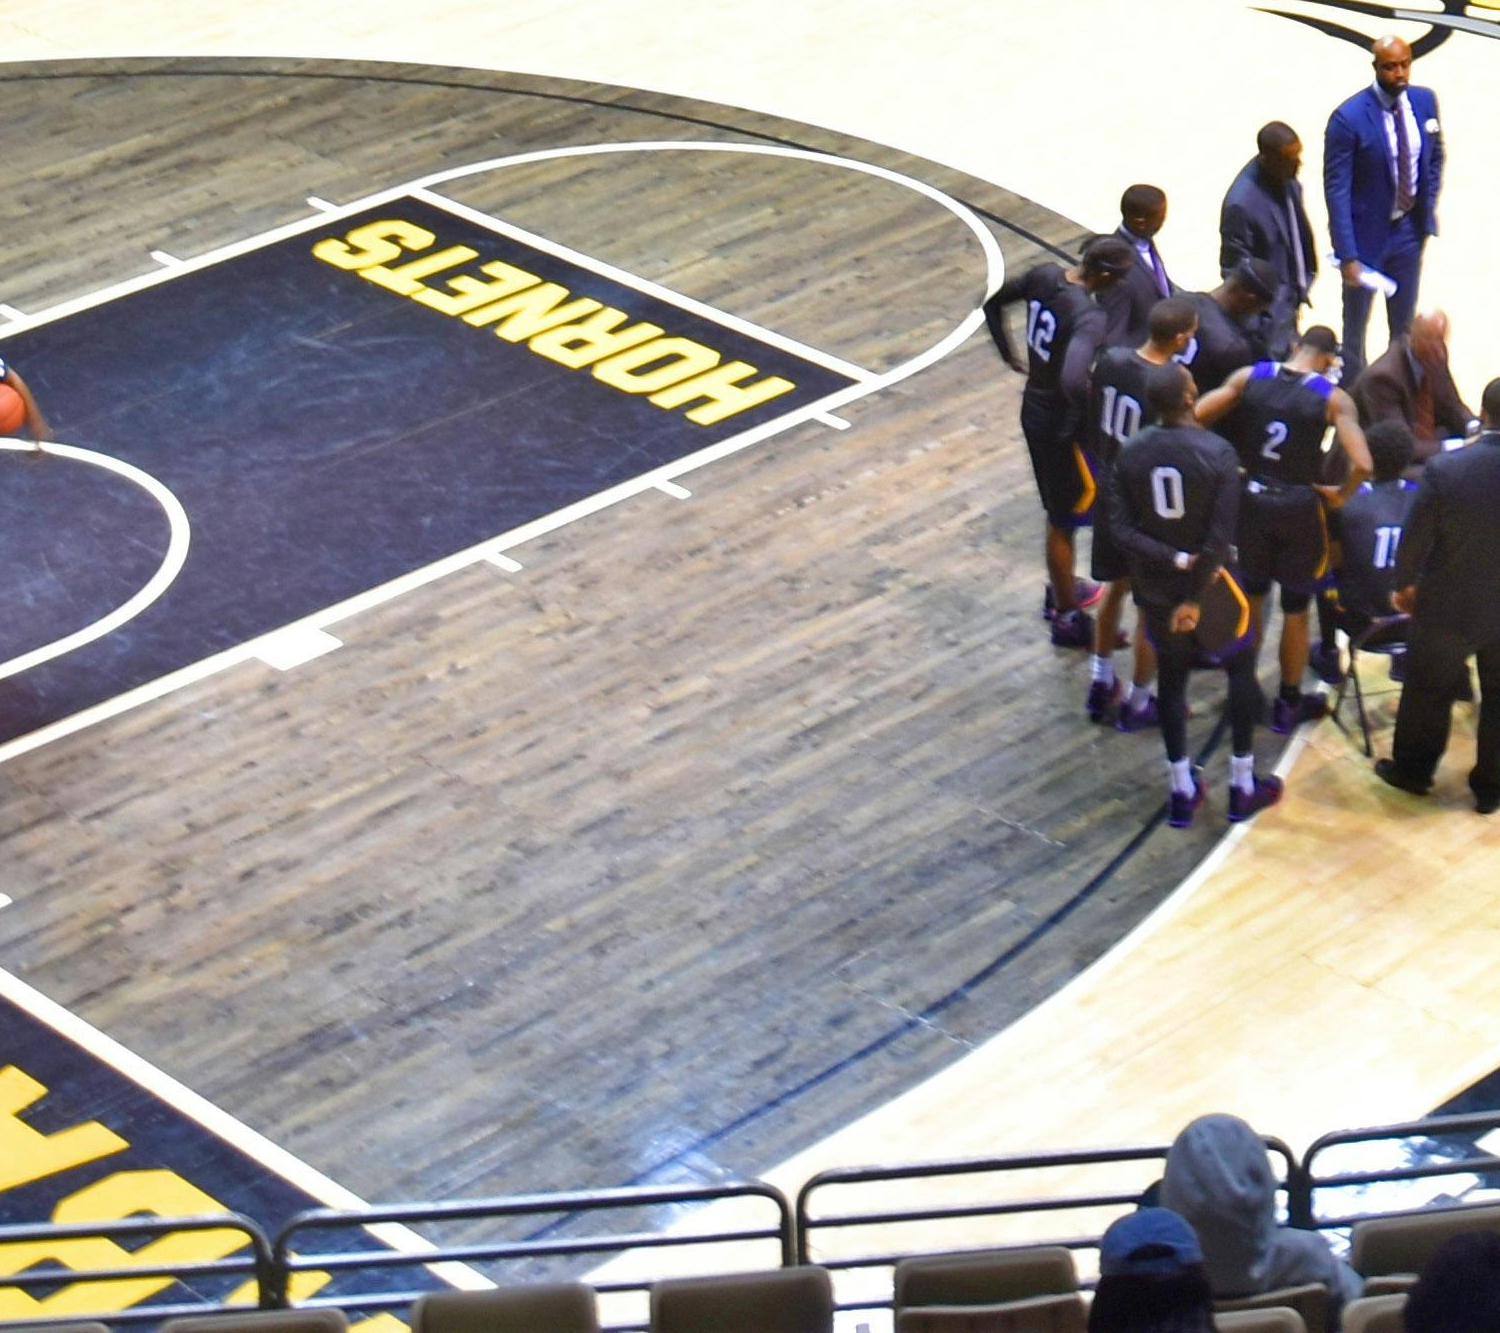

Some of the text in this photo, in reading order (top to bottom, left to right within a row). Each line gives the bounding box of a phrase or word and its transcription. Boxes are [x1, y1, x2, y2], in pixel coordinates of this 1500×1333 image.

[312, 218, 797, 426] HORNETS
[1026, 298, 1057, 363] 12
[1101, 385, 1142, 443] 10
[1262, 420, 1289, 461] 2
[1150, 465, 1186, 521] 0
